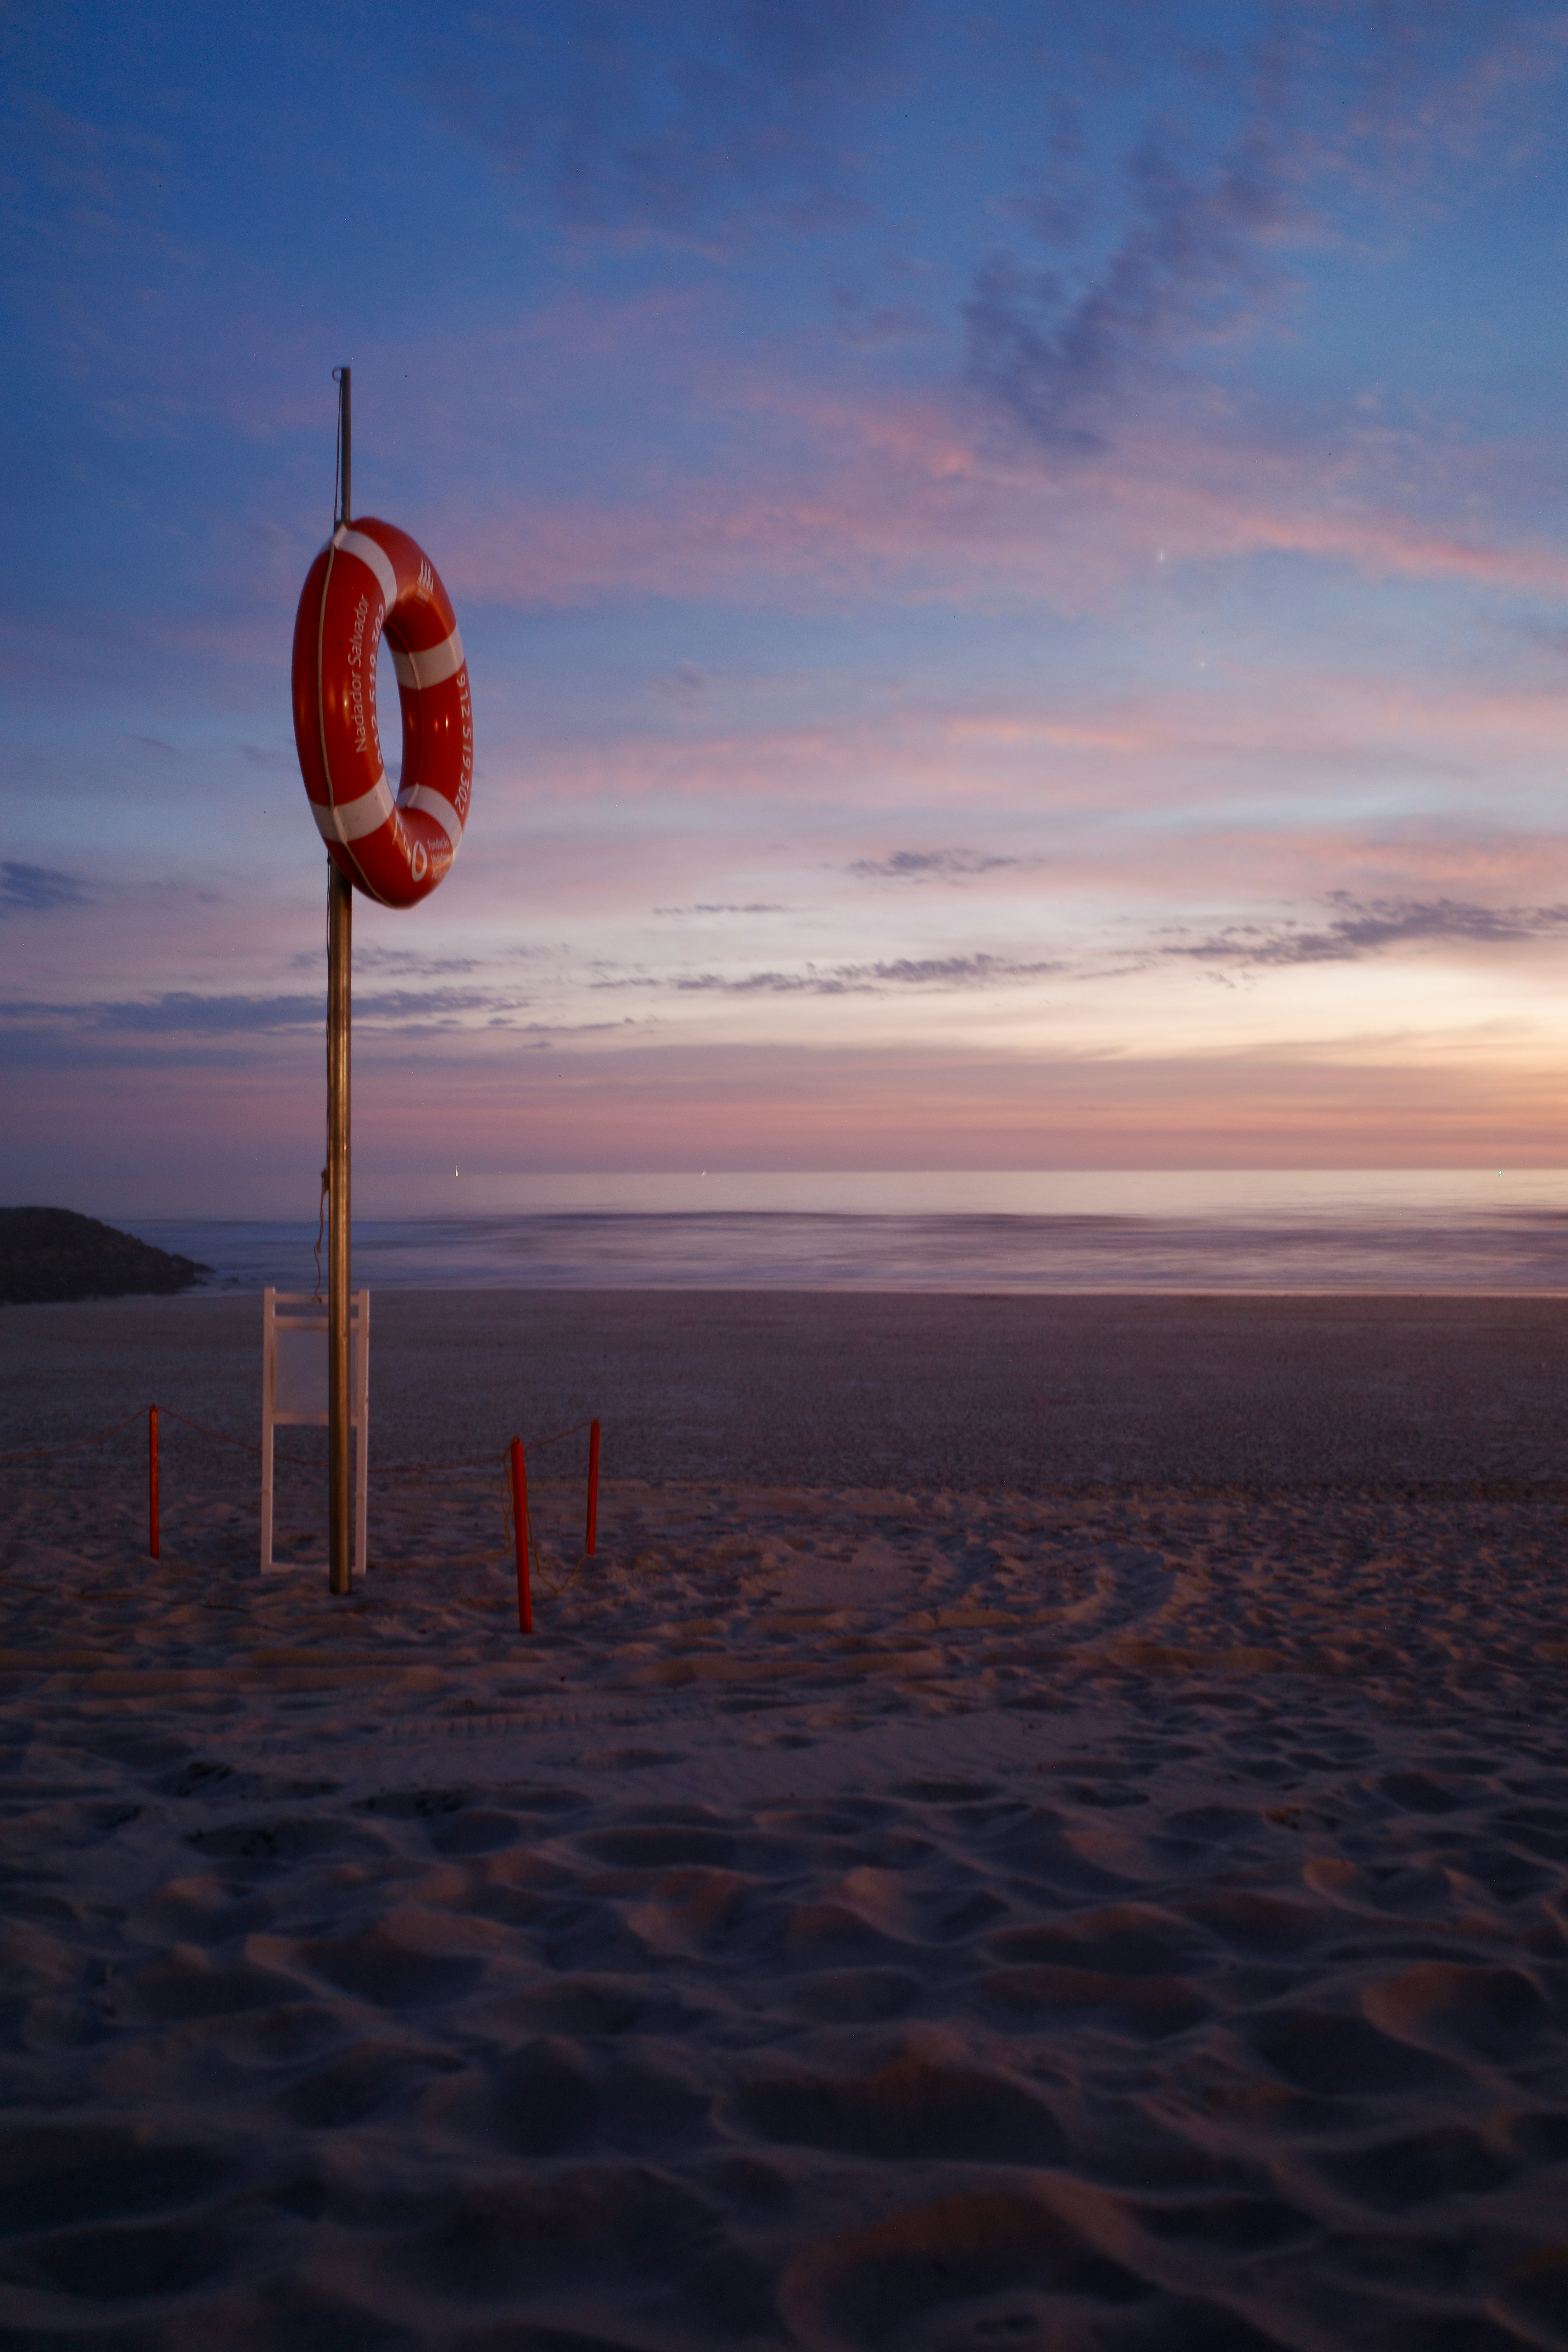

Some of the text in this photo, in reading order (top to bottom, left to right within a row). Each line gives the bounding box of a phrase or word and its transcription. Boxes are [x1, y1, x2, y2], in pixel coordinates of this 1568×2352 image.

[348, 592, 369, 753] Nadador Salvador
[455, 673, 471, 815] 912 519 302
